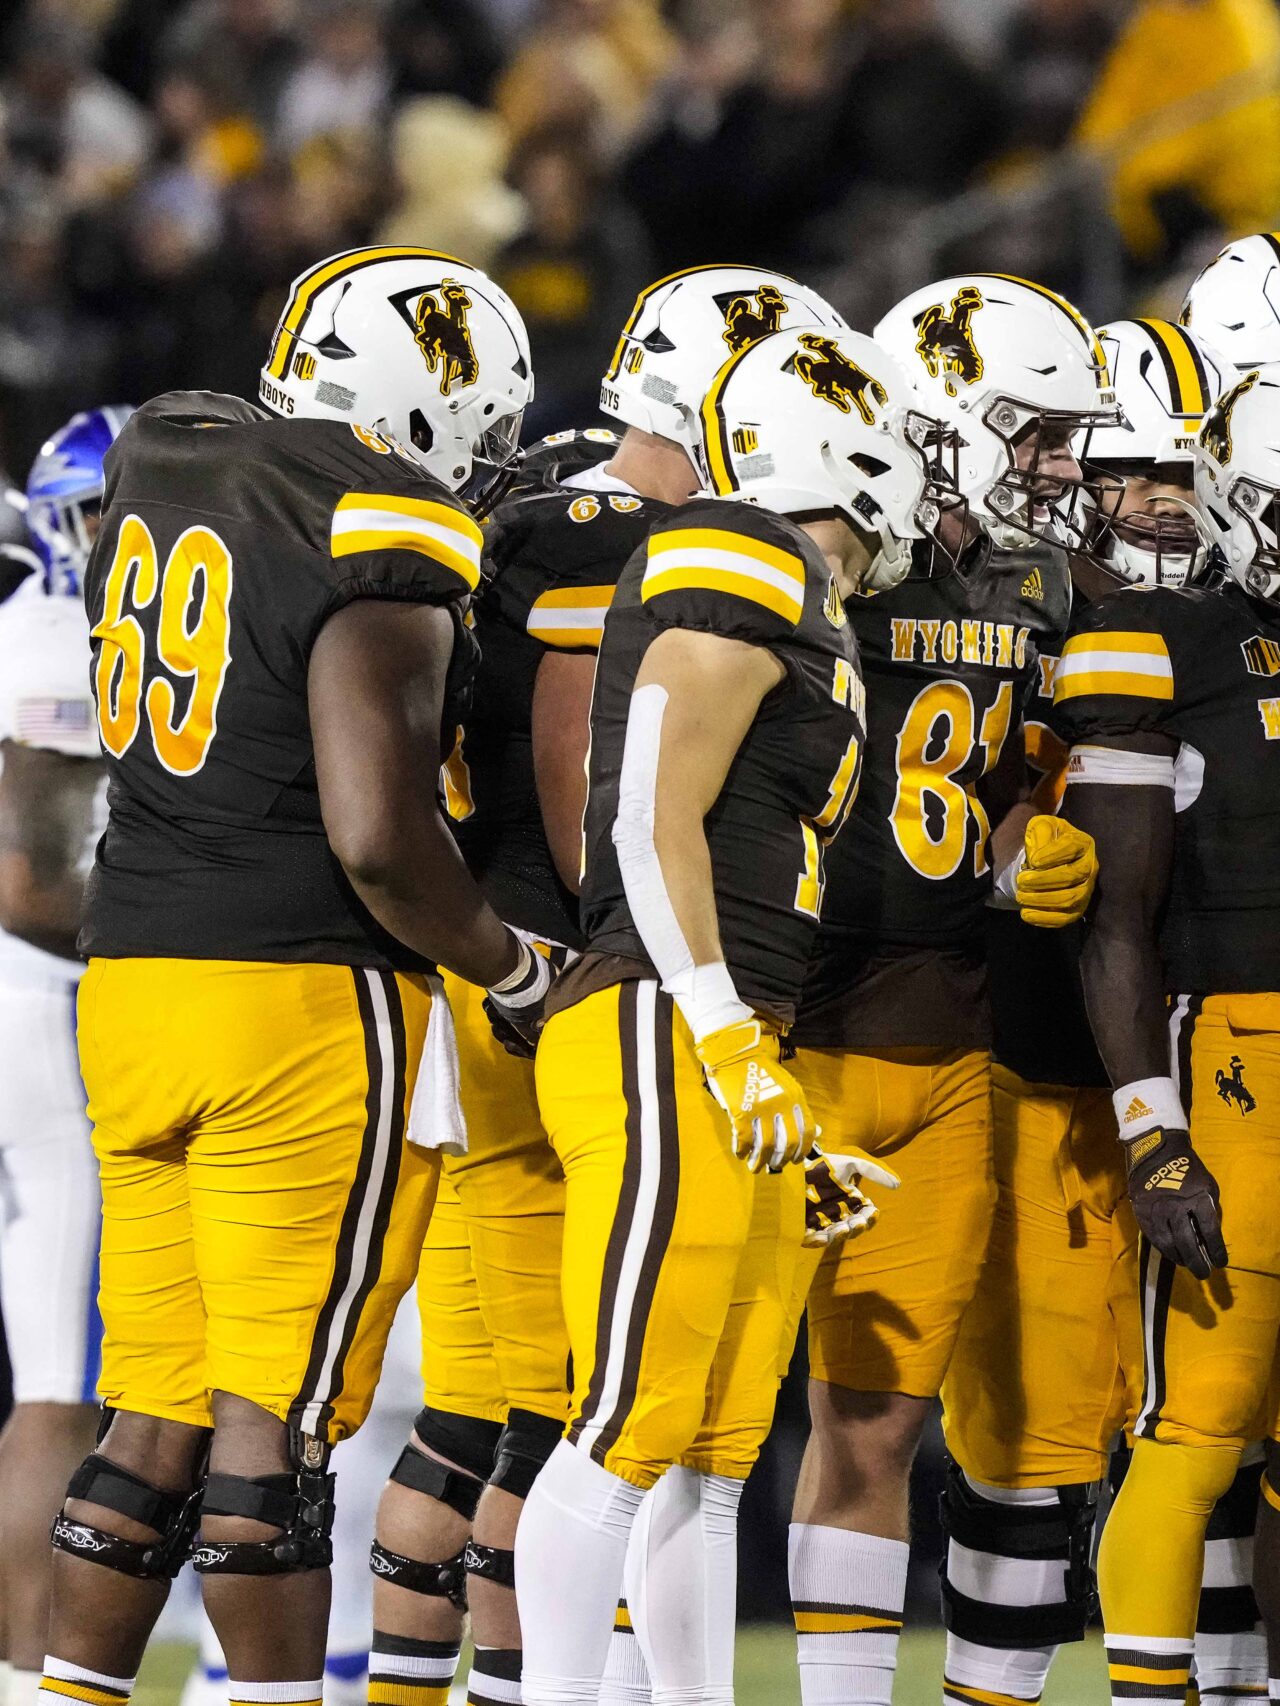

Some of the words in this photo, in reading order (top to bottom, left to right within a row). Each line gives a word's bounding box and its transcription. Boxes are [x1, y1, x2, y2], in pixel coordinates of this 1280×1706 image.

[89, 514, 233, 777] 69
[890, 618, 1031, 670] WYOMING
[741, 1061, 759, 1112] adidas
[1123, 1107, 1155, 1125] adidas
[1144, 1156, 1190, 1192] adidas
[54, 1525, 107, 1552] DONJOY
